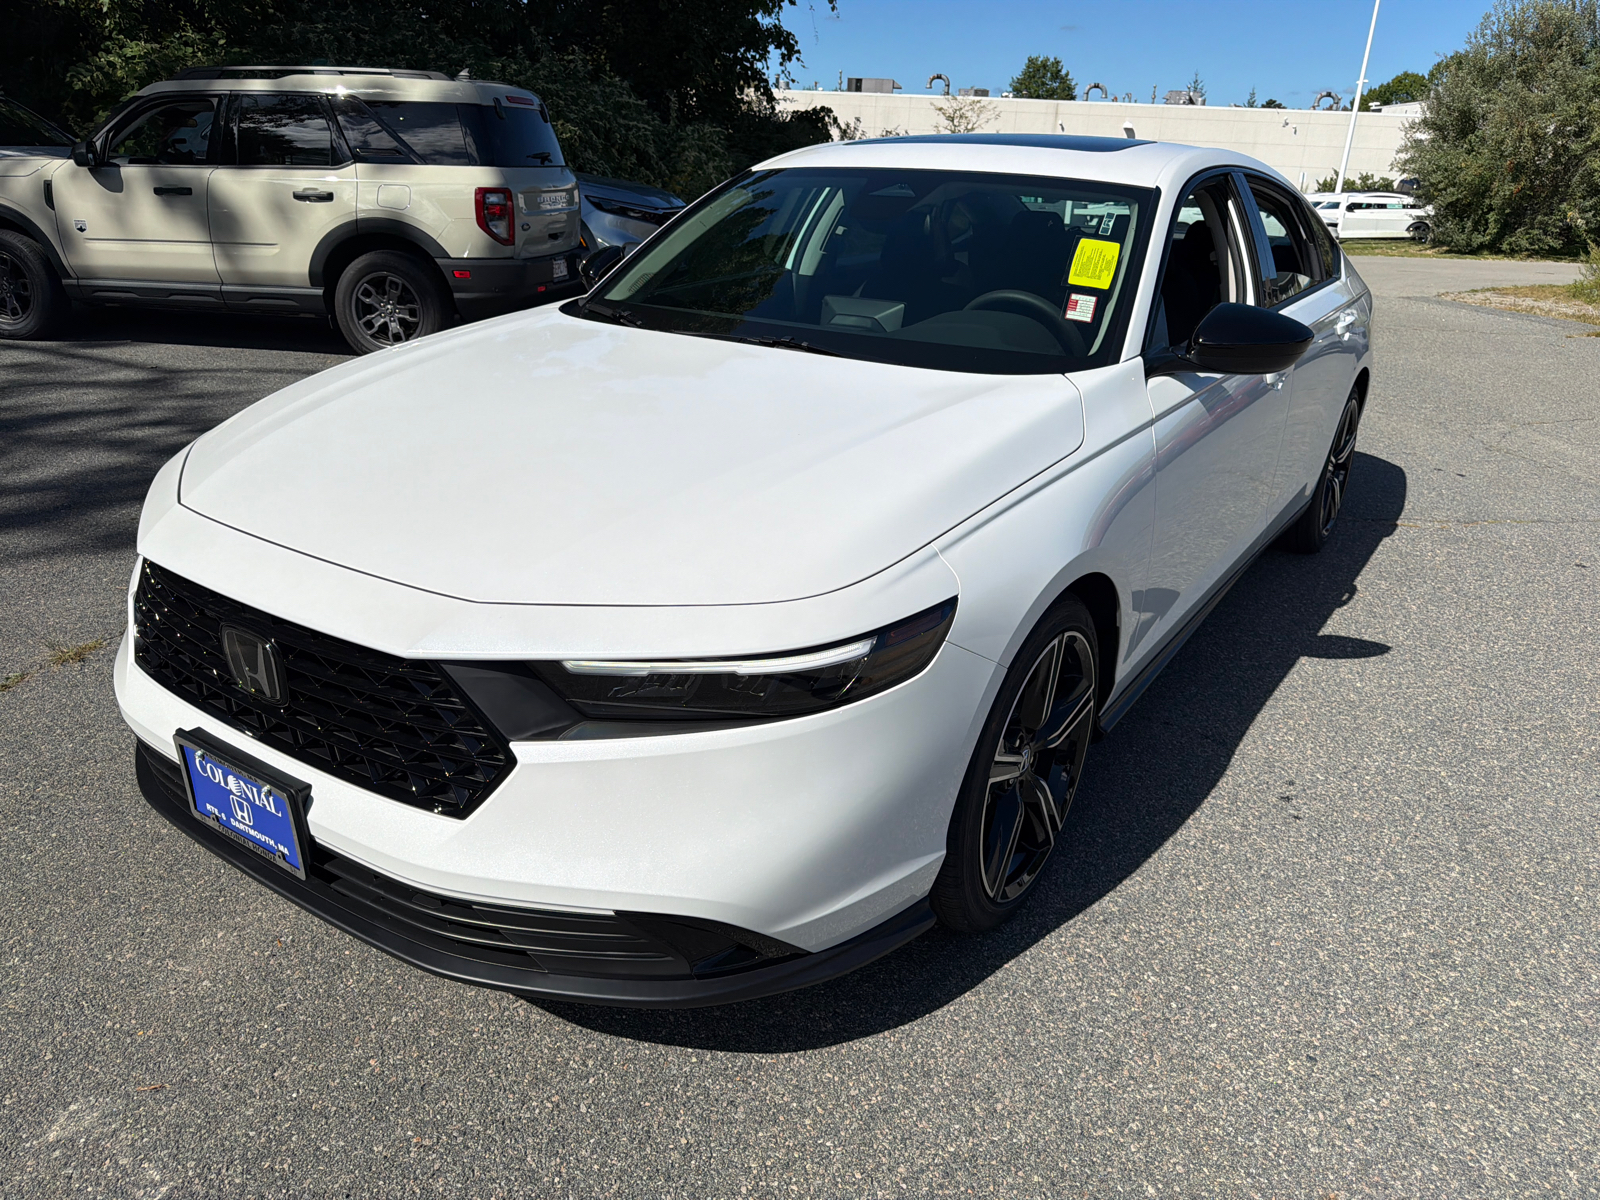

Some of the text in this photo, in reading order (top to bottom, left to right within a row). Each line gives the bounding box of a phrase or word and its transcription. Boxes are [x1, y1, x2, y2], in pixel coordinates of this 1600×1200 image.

[195, 756, 282, 818] COLONIAL
[205, 802, 221, 818] RTE.
[230, 817, 277, 850] DARTMOUTH,
[277, 843, 290, 856] MA
